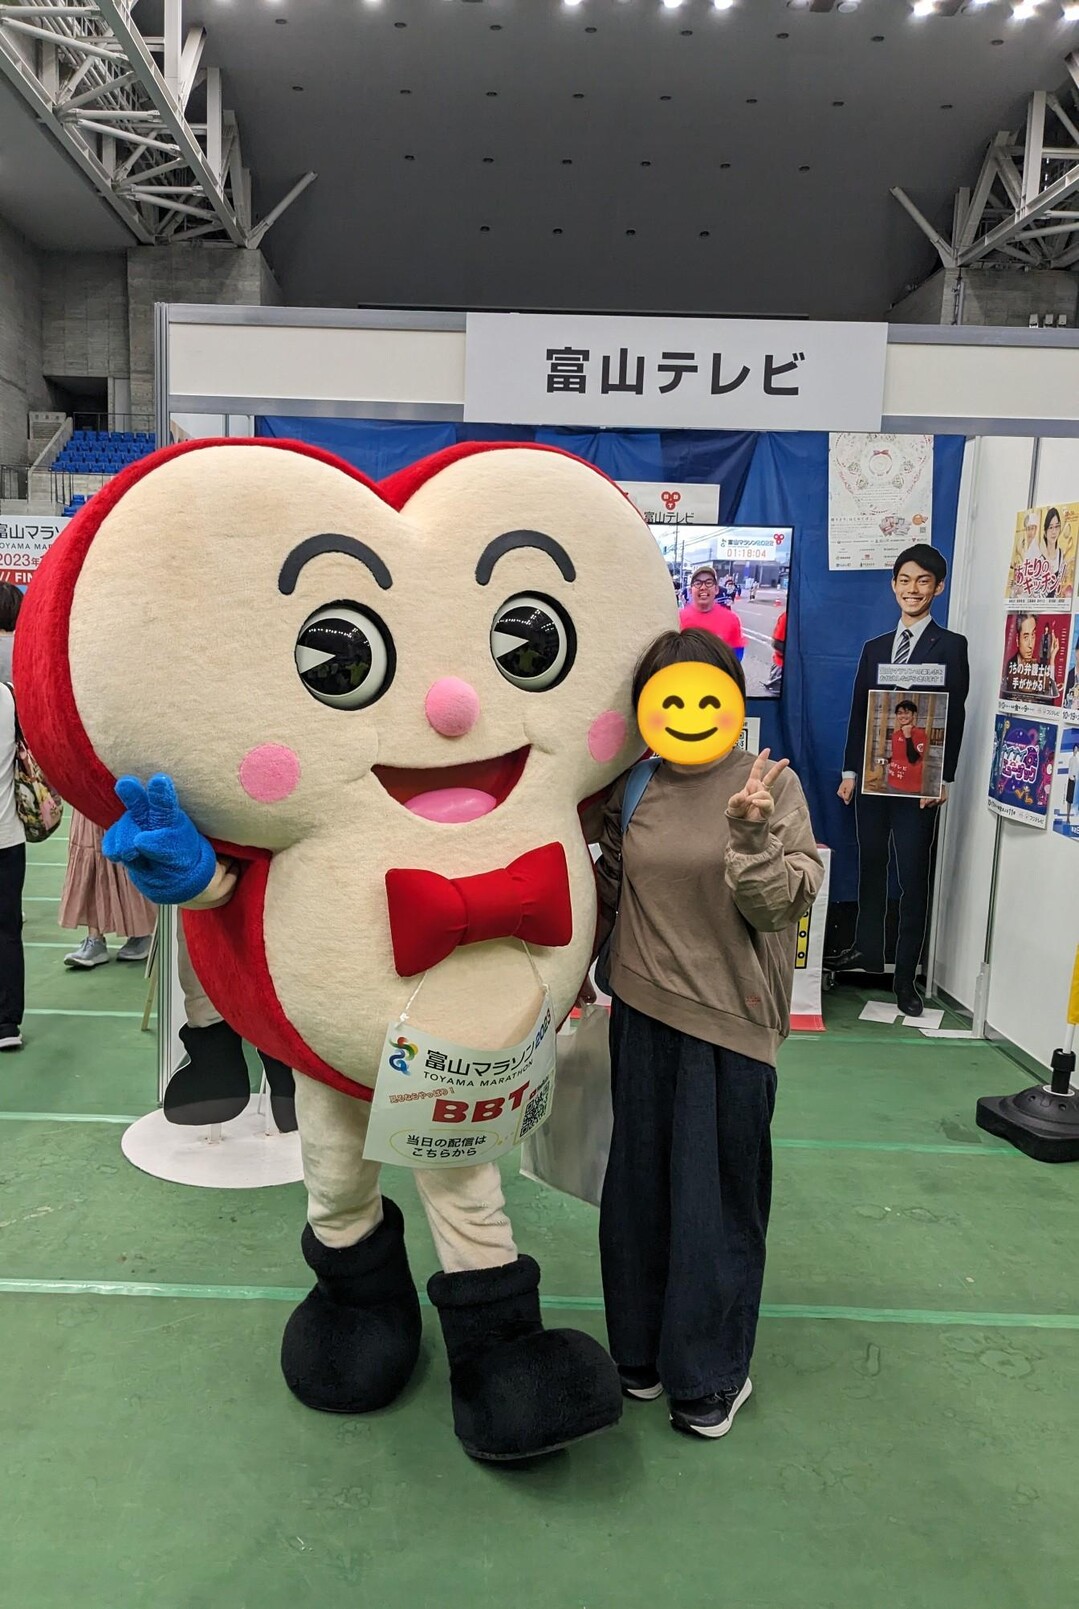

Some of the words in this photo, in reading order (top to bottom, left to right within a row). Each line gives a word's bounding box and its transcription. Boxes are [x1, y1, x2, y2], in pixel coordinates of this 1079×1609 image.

[546, 346, 806, 397] 富山テレビ
[644, 511, 695, 524] 富山テレビ
[0, 553, 44, 567] 2023年
[727, 548, 766, 558] 01:18:04
[1009, 661, 1050, 676] うちの弁護士は
[423, 1071, 475, 1087] TOYAMA
[479, 1059, 534, 1088] MARATHON
[431, 1080, 531, 1124] BBT
[406, 1134, 488, 1148] 当日の配信は
[411, 1147, 478, 1159] こちらから
